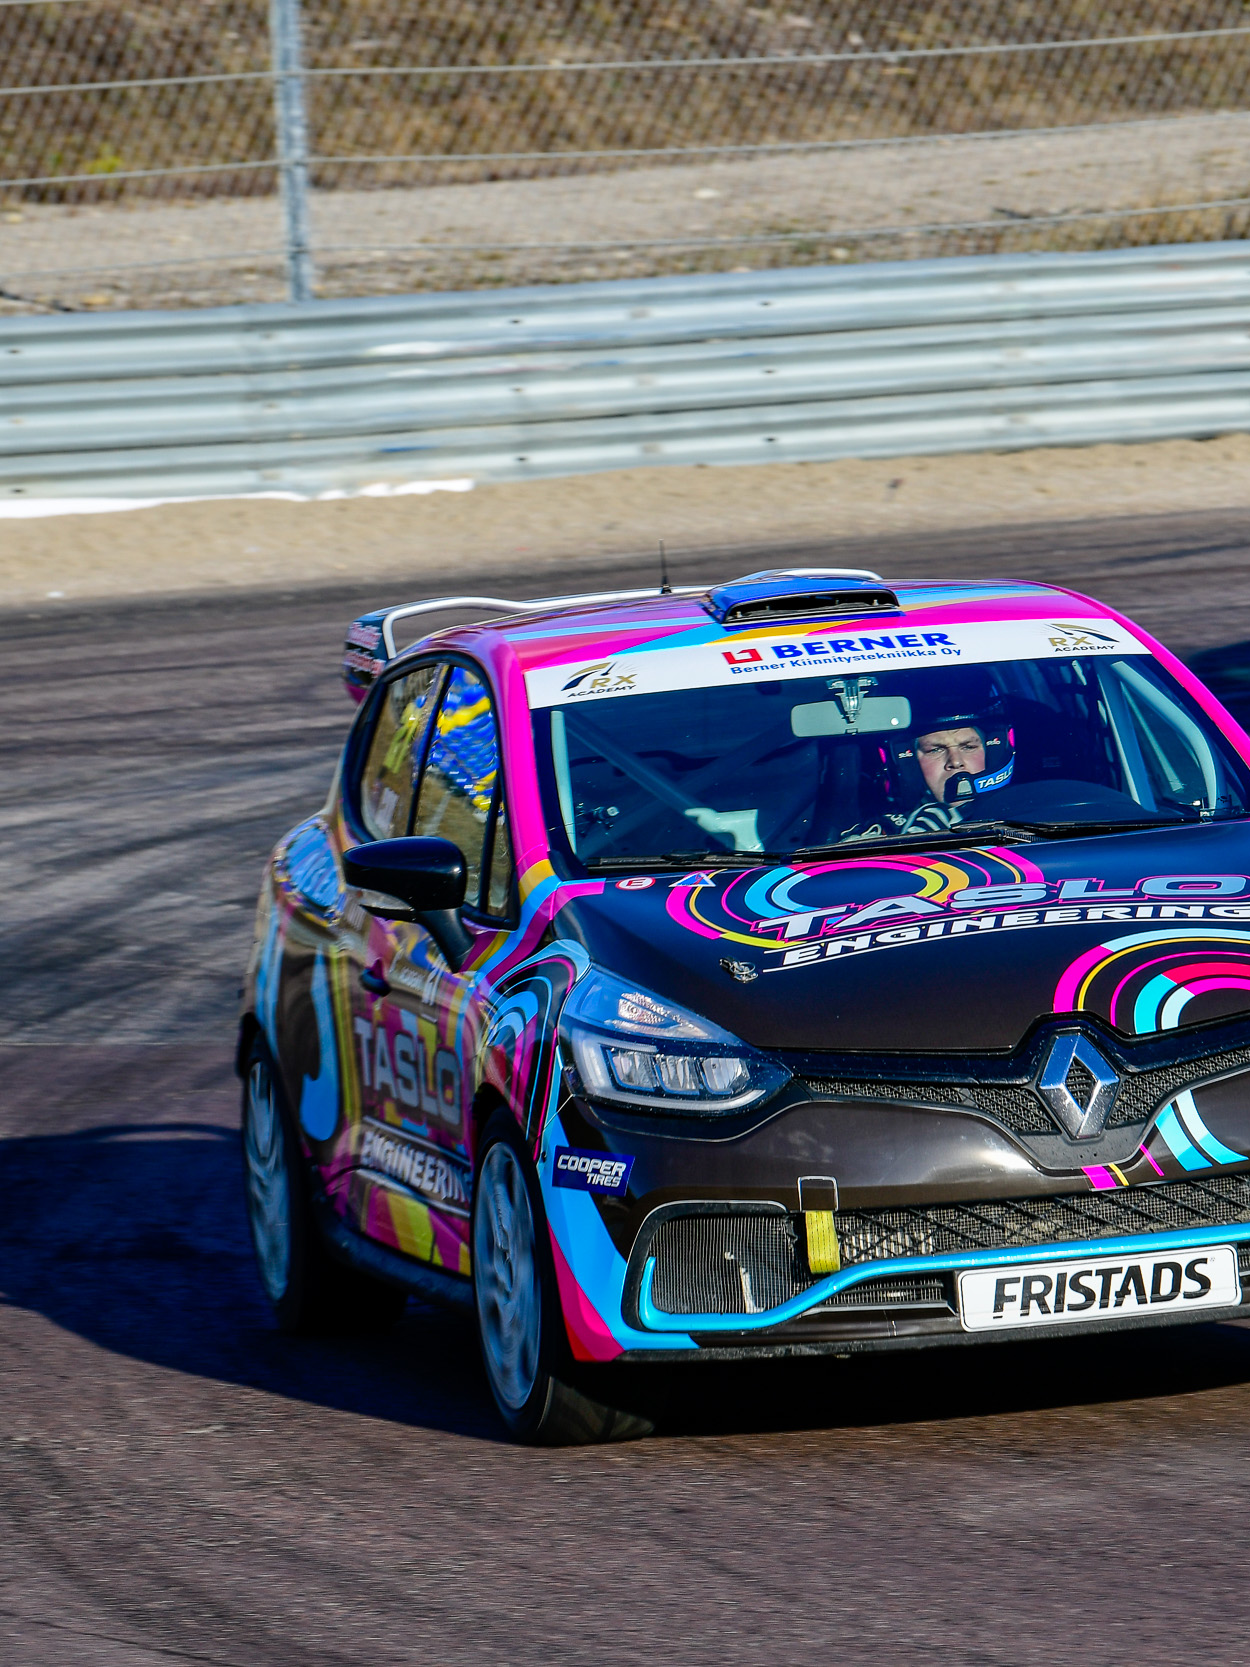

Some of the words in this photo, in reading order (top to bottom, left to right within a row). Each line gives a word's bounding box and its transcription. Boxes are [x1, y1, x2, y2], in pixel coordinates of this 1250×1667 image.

[771, 632, 957, 659] BERNER
[1048, 636, 1093, 647] RX
[1054, 645, 1115, 653] ACADEMY
[730, 662, 786, 675] Berner
[790, 648, 937, 668] Kiinnitystekniikka
[941, 647, 962, 659] Oy
[567, 684, 636, 698] ACADEMY
[590, 673, 637, 689] RX
[757, 875, 1248, 939] TASLO
[354, 1016, 461, 1126] TASLO
[557, 1154, 627, 1177] COOPER
[586, 1172, 622, 1188] TIRES
[992, 1257, 1212, 1320] FRISTADS
